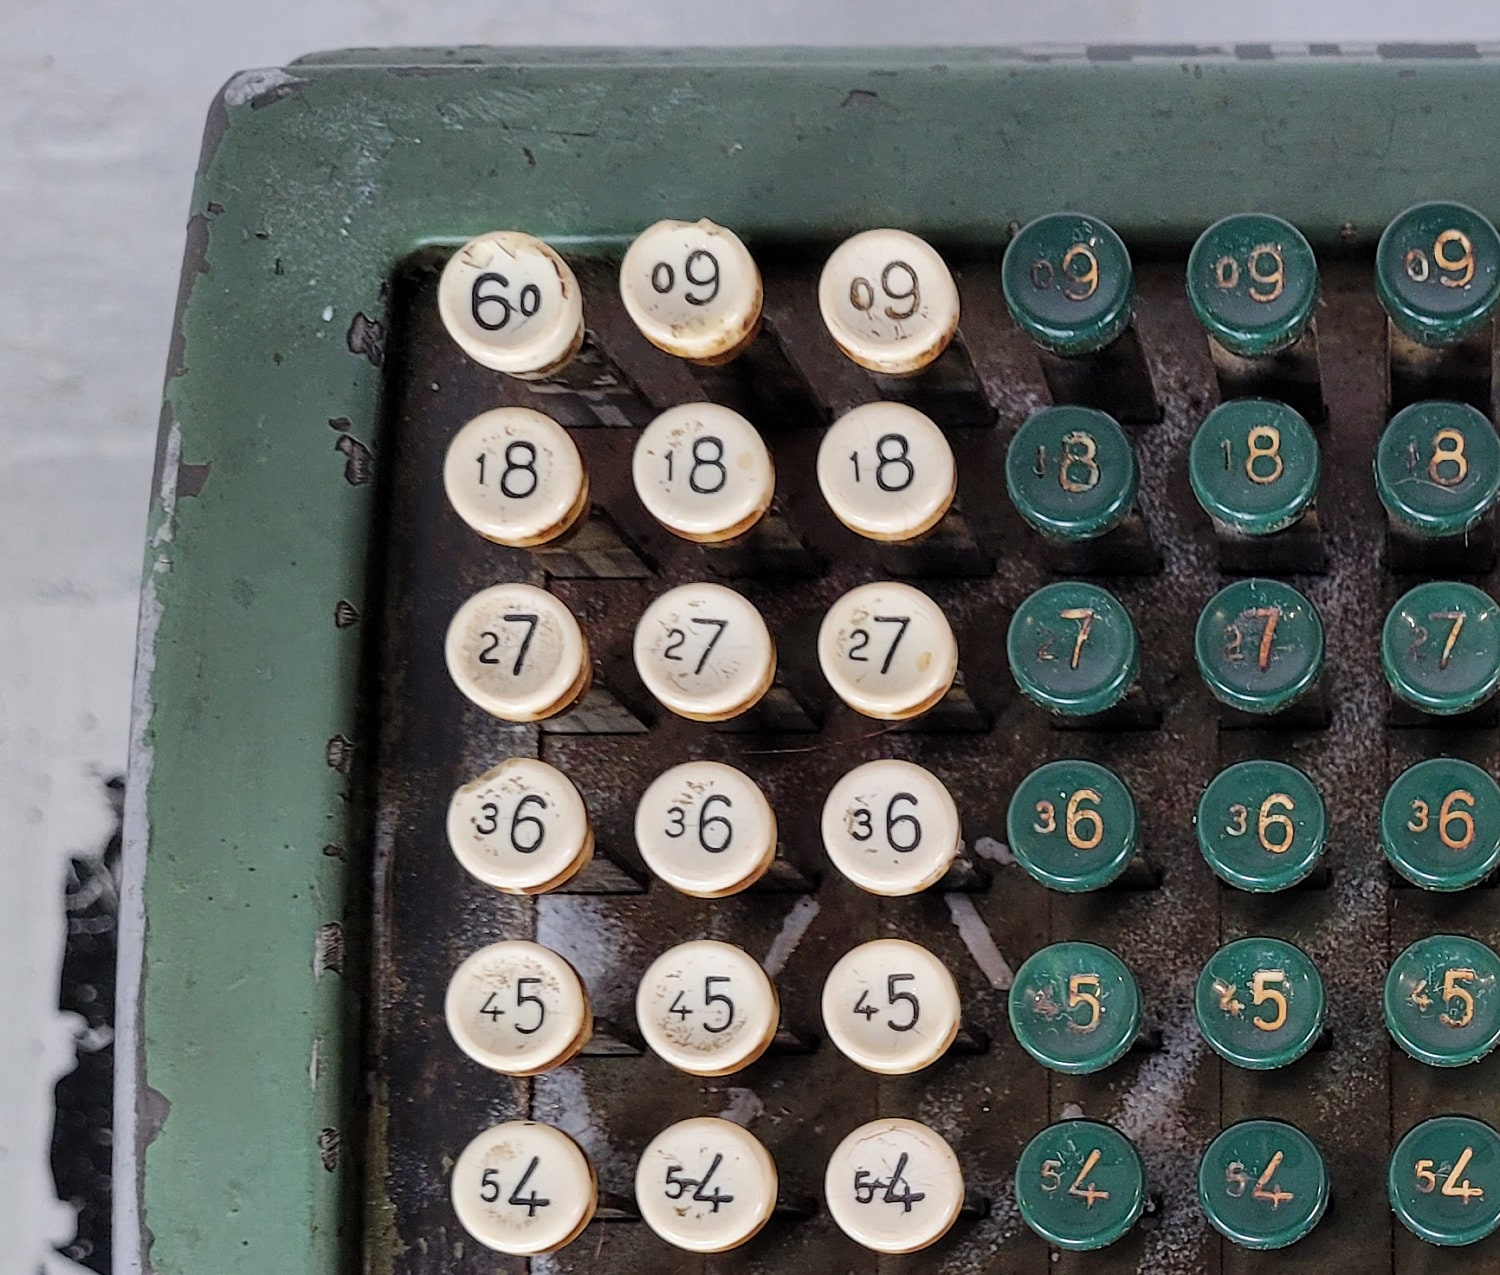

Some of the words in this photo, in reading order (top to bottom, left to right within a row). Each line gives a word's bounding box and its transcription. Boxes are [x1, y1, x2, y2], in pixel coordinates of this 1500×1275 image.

[475, 441, 538, 499] 18
[663, 435, 727, 494] 18
[849, 433, 915, 492] 18
[478, 614, 539, 676] 27
[663, 617, 729, 676] 27
[847, 616, 911, 675] 27
[475, 794, 548, 854] 36
[664, 794, 733, 854] 36
[852, 791, 922, 853] 36
[1033, 788, 1104, 850] 36
[1224, 792, 1295, 854] 36
[1406, 789, 1476, 849] 36
[480, 976, 545, 1035] 45
[668, 975, 735, 1034] 45
[853, 973, 921, 1032] 45
[479, 1155, 551, 1217] 54
